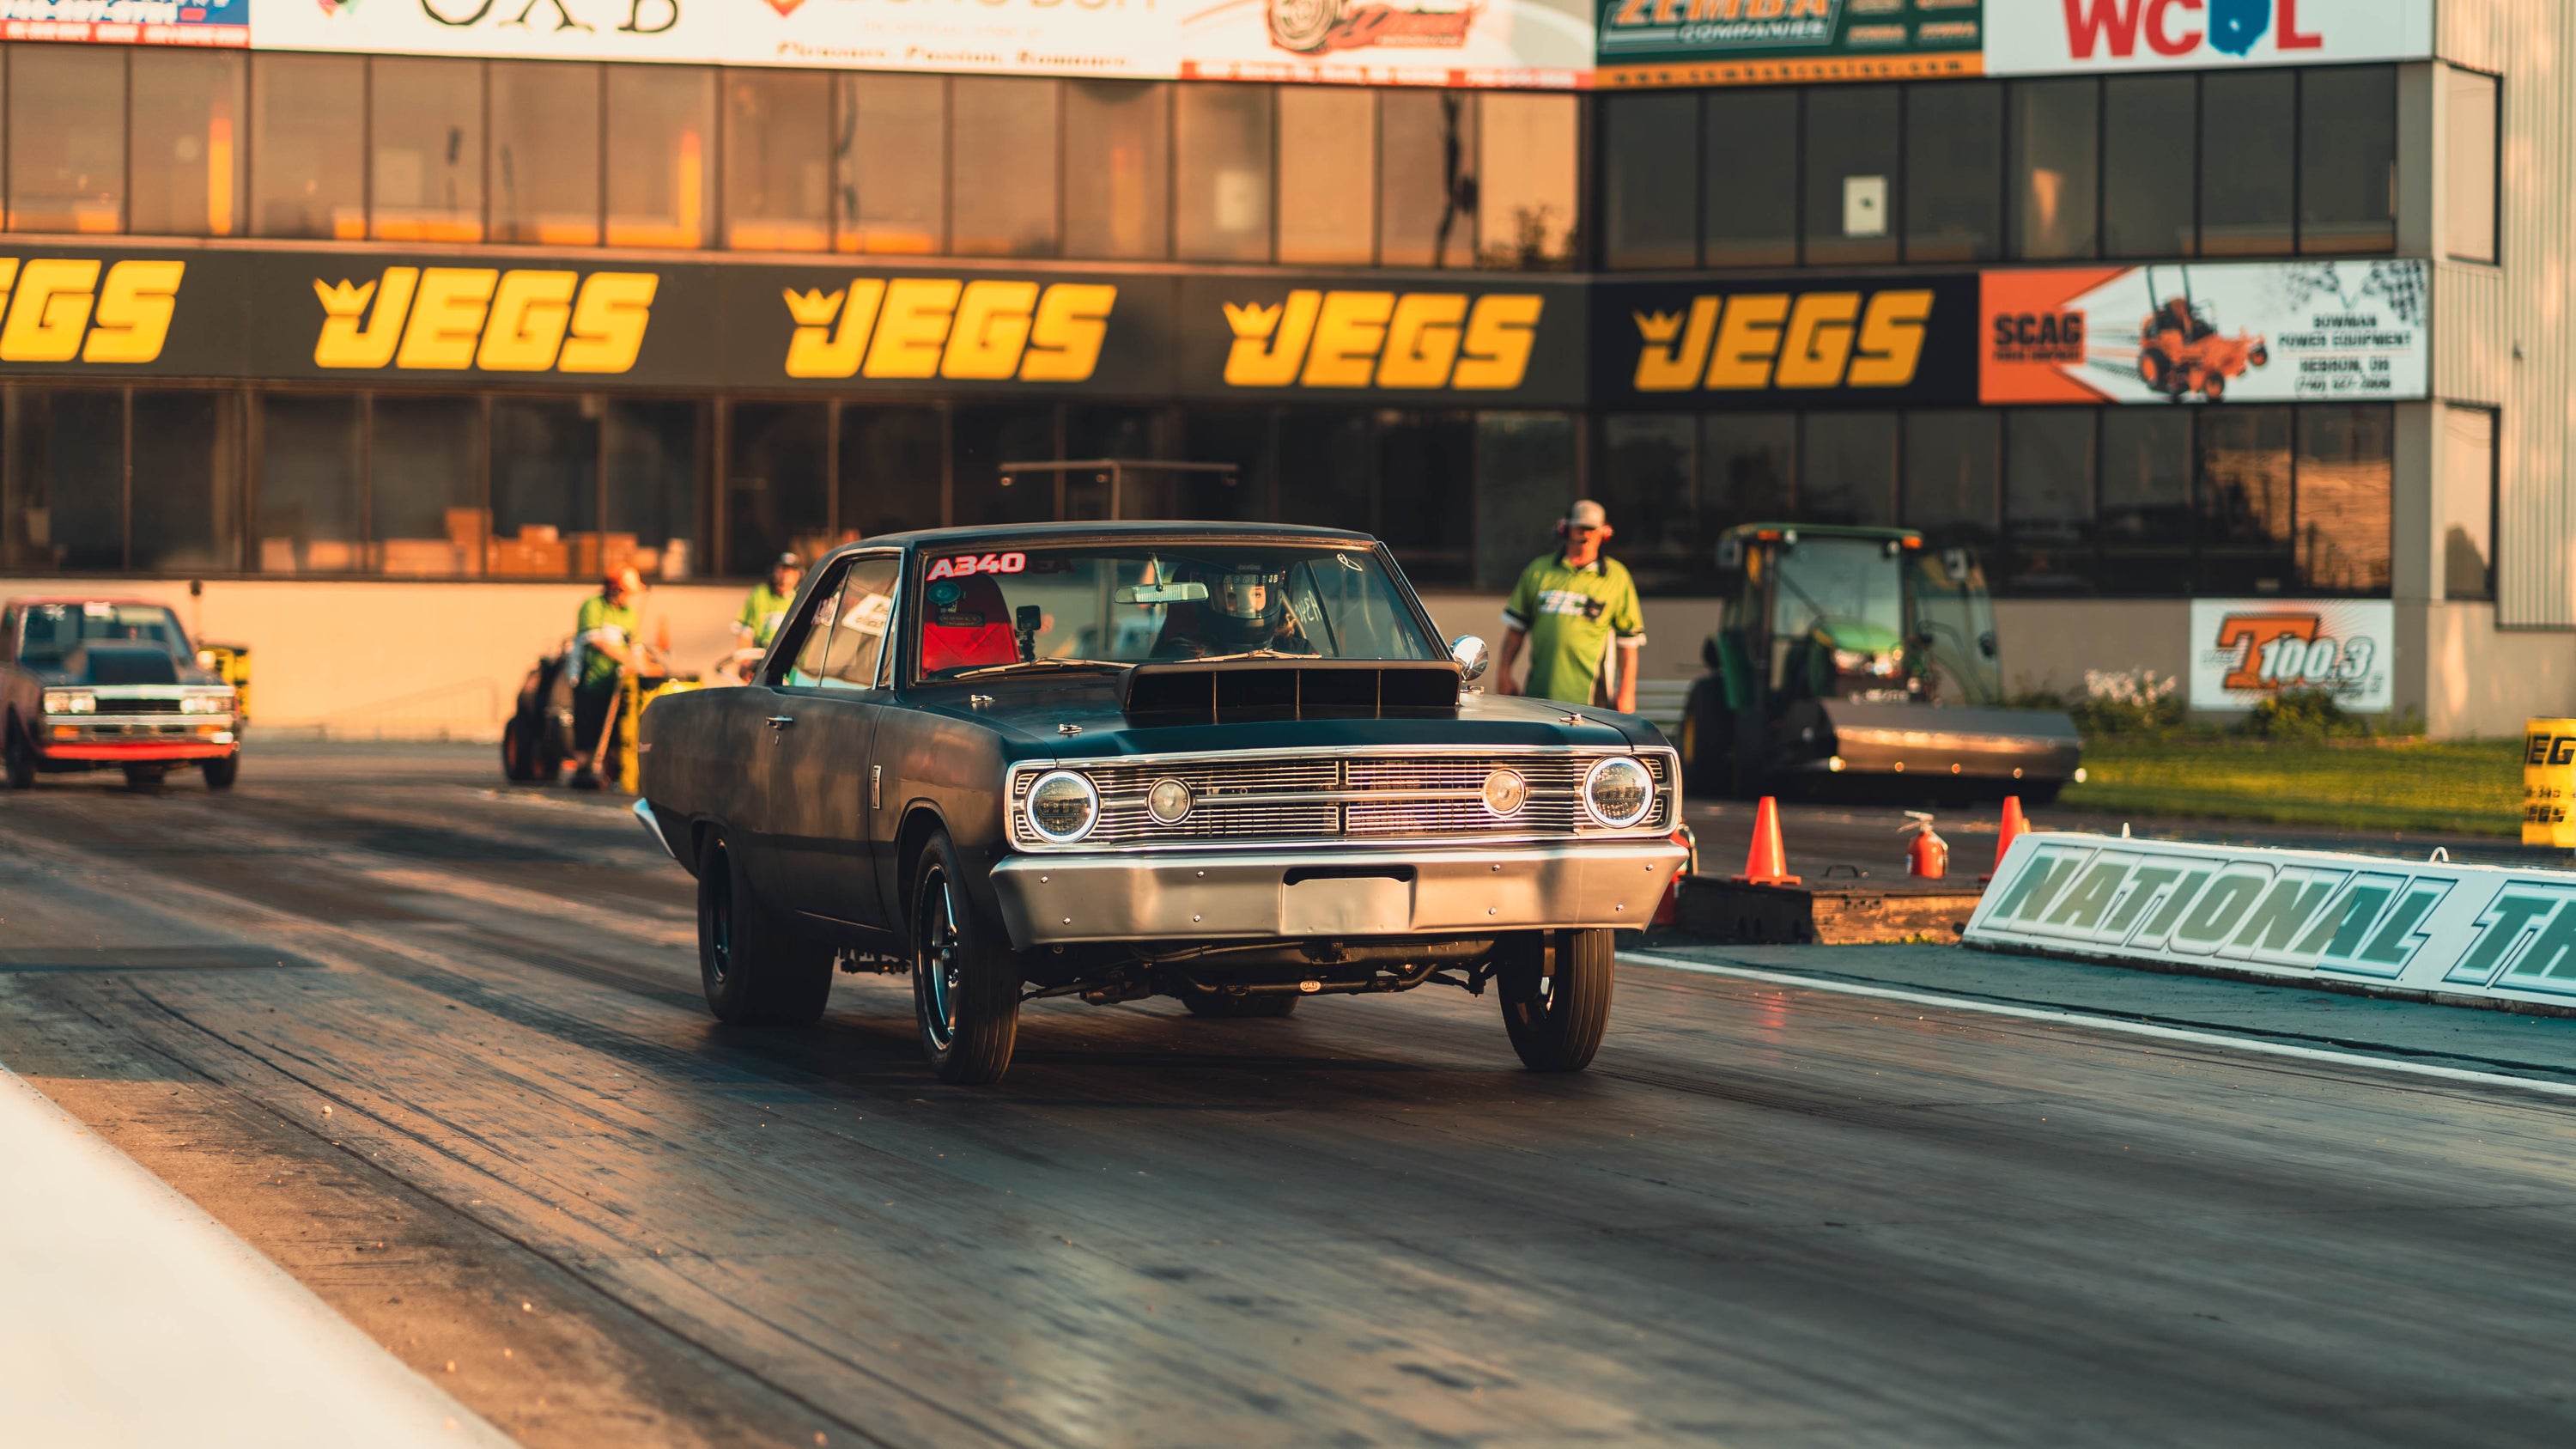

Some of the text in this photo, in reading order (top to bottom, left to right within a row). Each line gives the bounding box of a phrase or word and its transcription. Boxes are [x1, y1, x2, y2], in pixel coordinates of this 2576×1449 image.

[1679, 21, 1826, 42] COMPANIES
[0, 259, 185, 362] GS
[313, 266, 659, 373] JEGS
[782, 278, 1117, 381] JEGS
[1223, 289, 1544, 389] JEGS
[1631, 289, 1935, 390] JEGS
[1994, 313, 2081, 345] SCAG
[926, 552, 1026, 581] A340
[1985, 847, 2450, 972] NATIONAL
